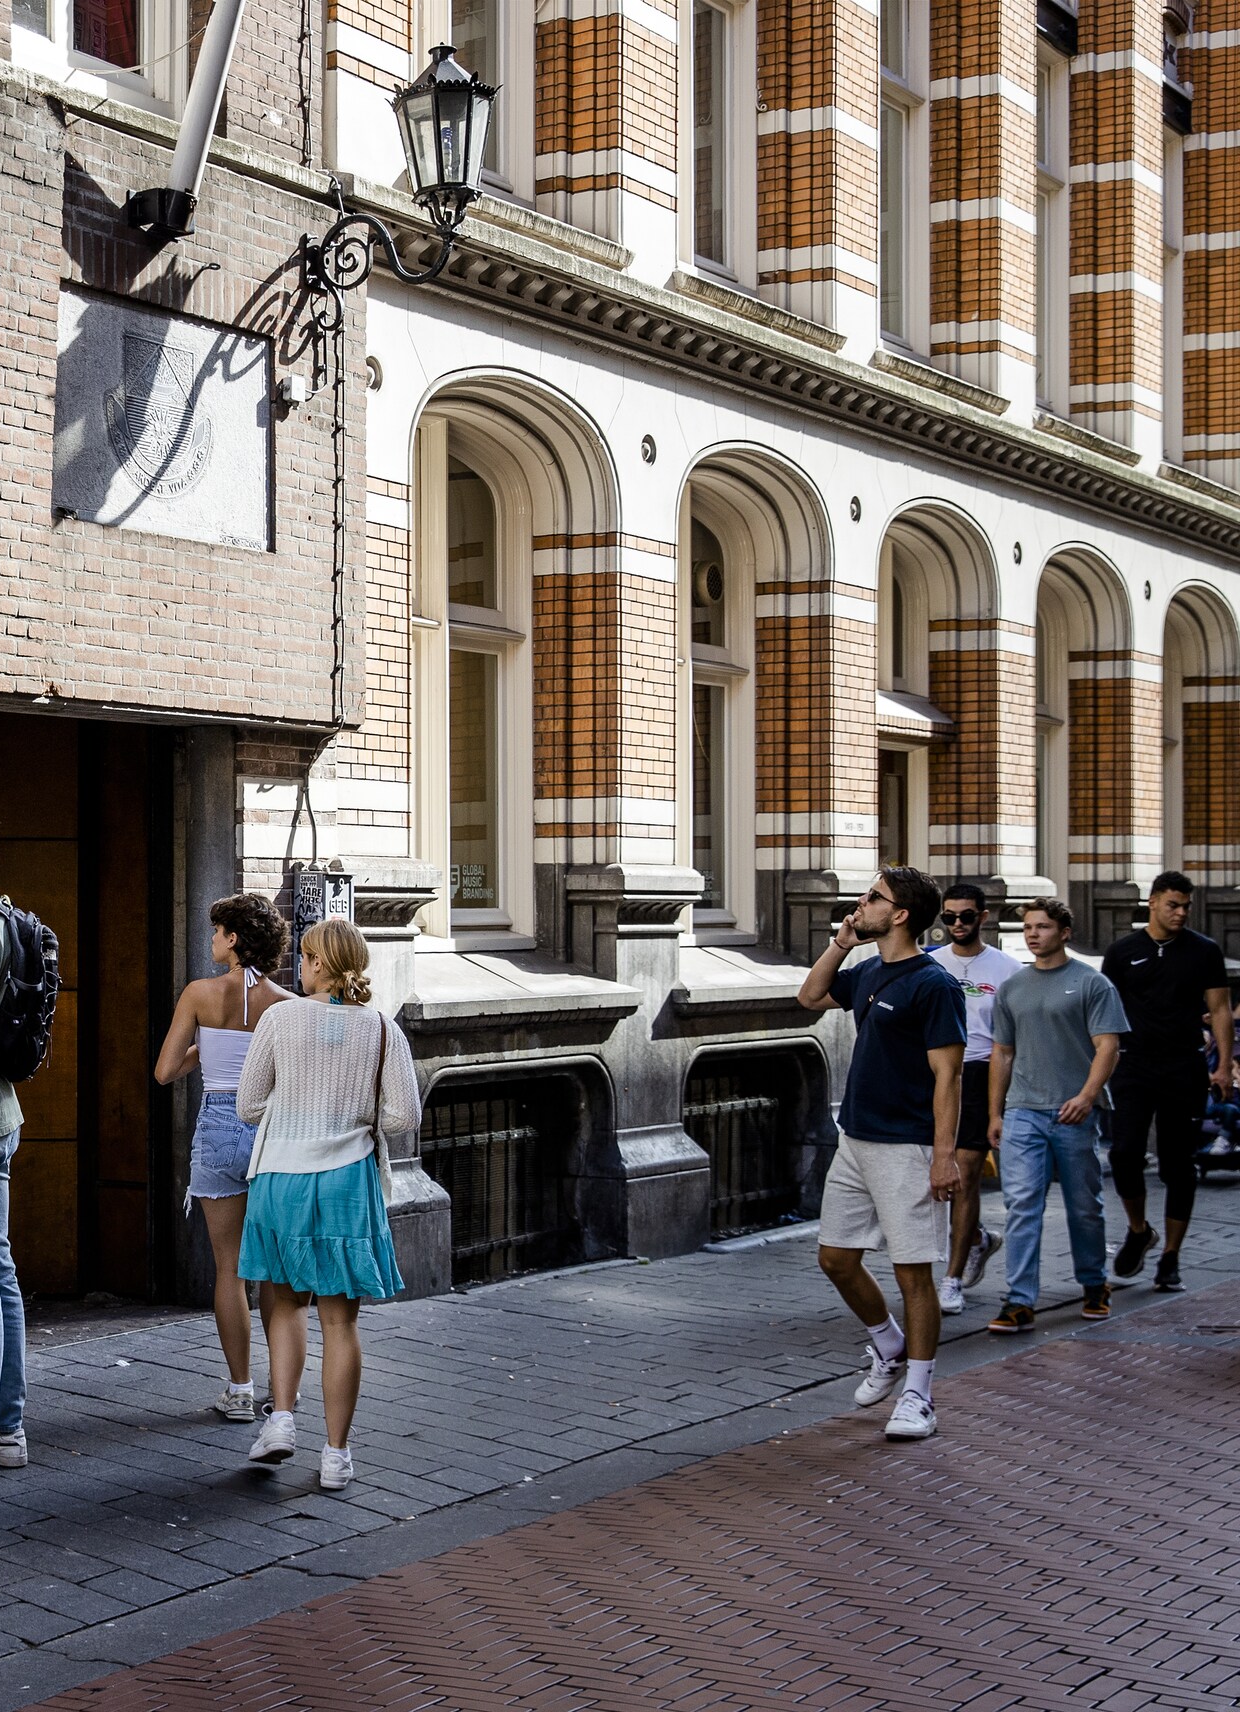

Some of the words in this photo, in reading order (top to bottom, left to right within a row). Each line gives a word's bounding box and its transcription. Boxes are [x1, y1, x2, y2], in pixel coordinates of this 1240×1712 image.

[462, 864, 485, 876] GLOBAL
[462, 876, 482, 887] MUSIC
[462, 887, 494, 899] BRANDING
